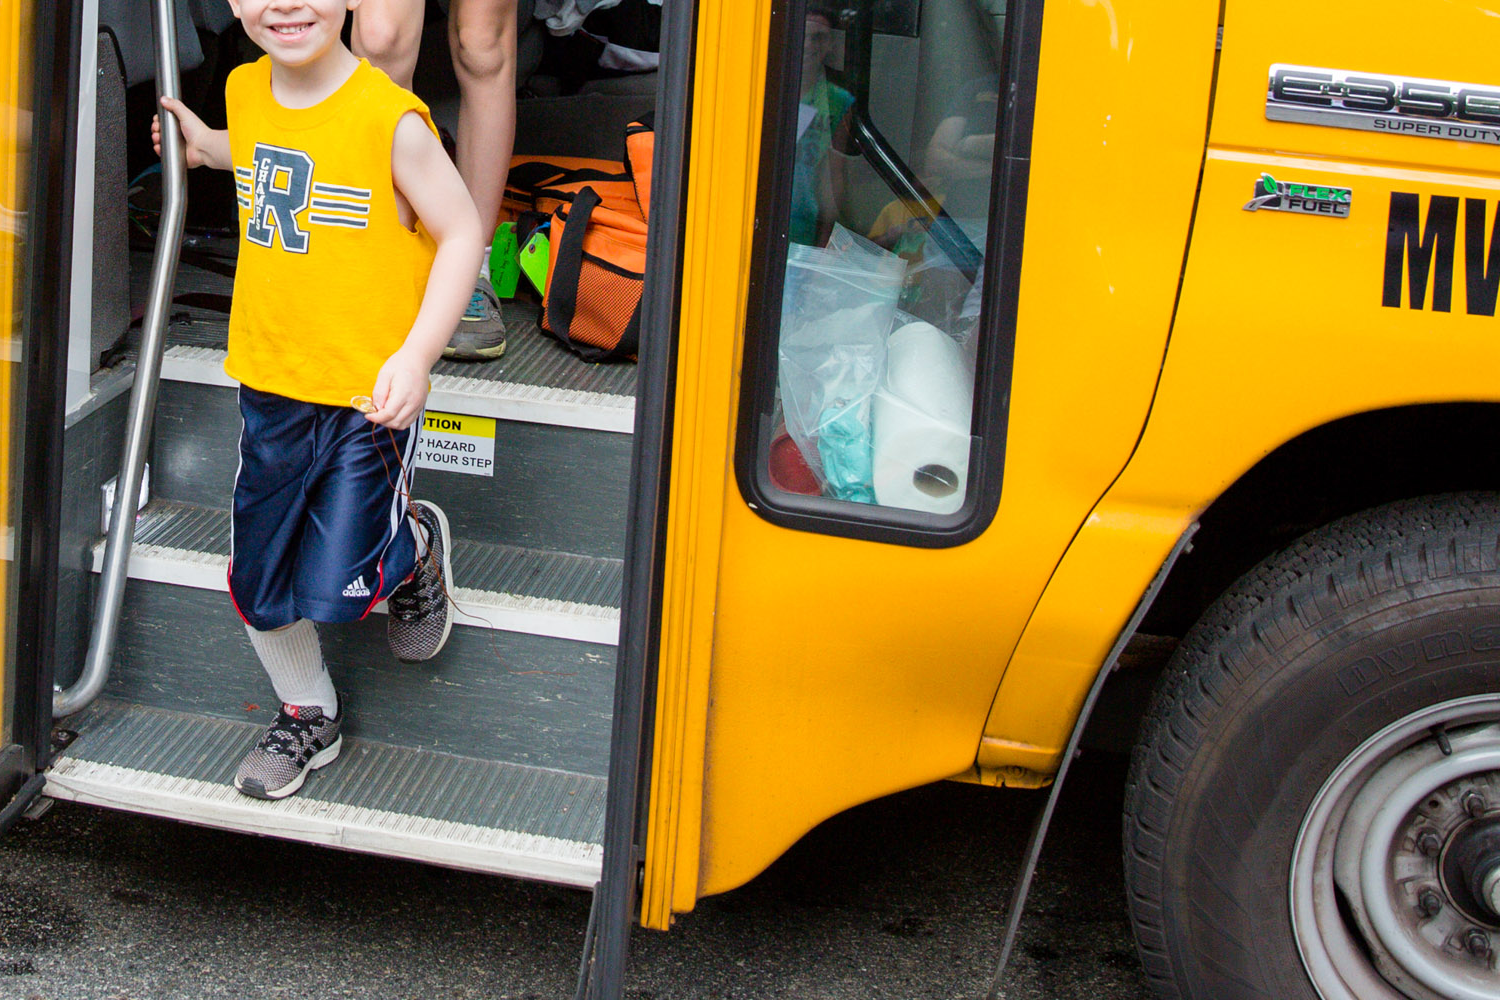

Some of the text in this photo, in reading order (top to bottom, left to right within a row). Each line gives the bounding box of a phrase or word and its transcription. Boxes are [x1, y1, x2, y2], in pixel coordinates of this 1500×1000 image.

[1373, 119, 1441, 135] SUPER
[246, 142, 315, 254] R
[255, 157, 271, 231] CHAMPS
[1289, 184, 1348, 202] FLEX
[1288, 199, 1344, 215] FUEL
[1382, 191, 1500, 317] MV
[427, 438, 476, 453] HAZARD
[425, 452, 458, 465] YOUR
[462, 456, 492, 468] STEP
